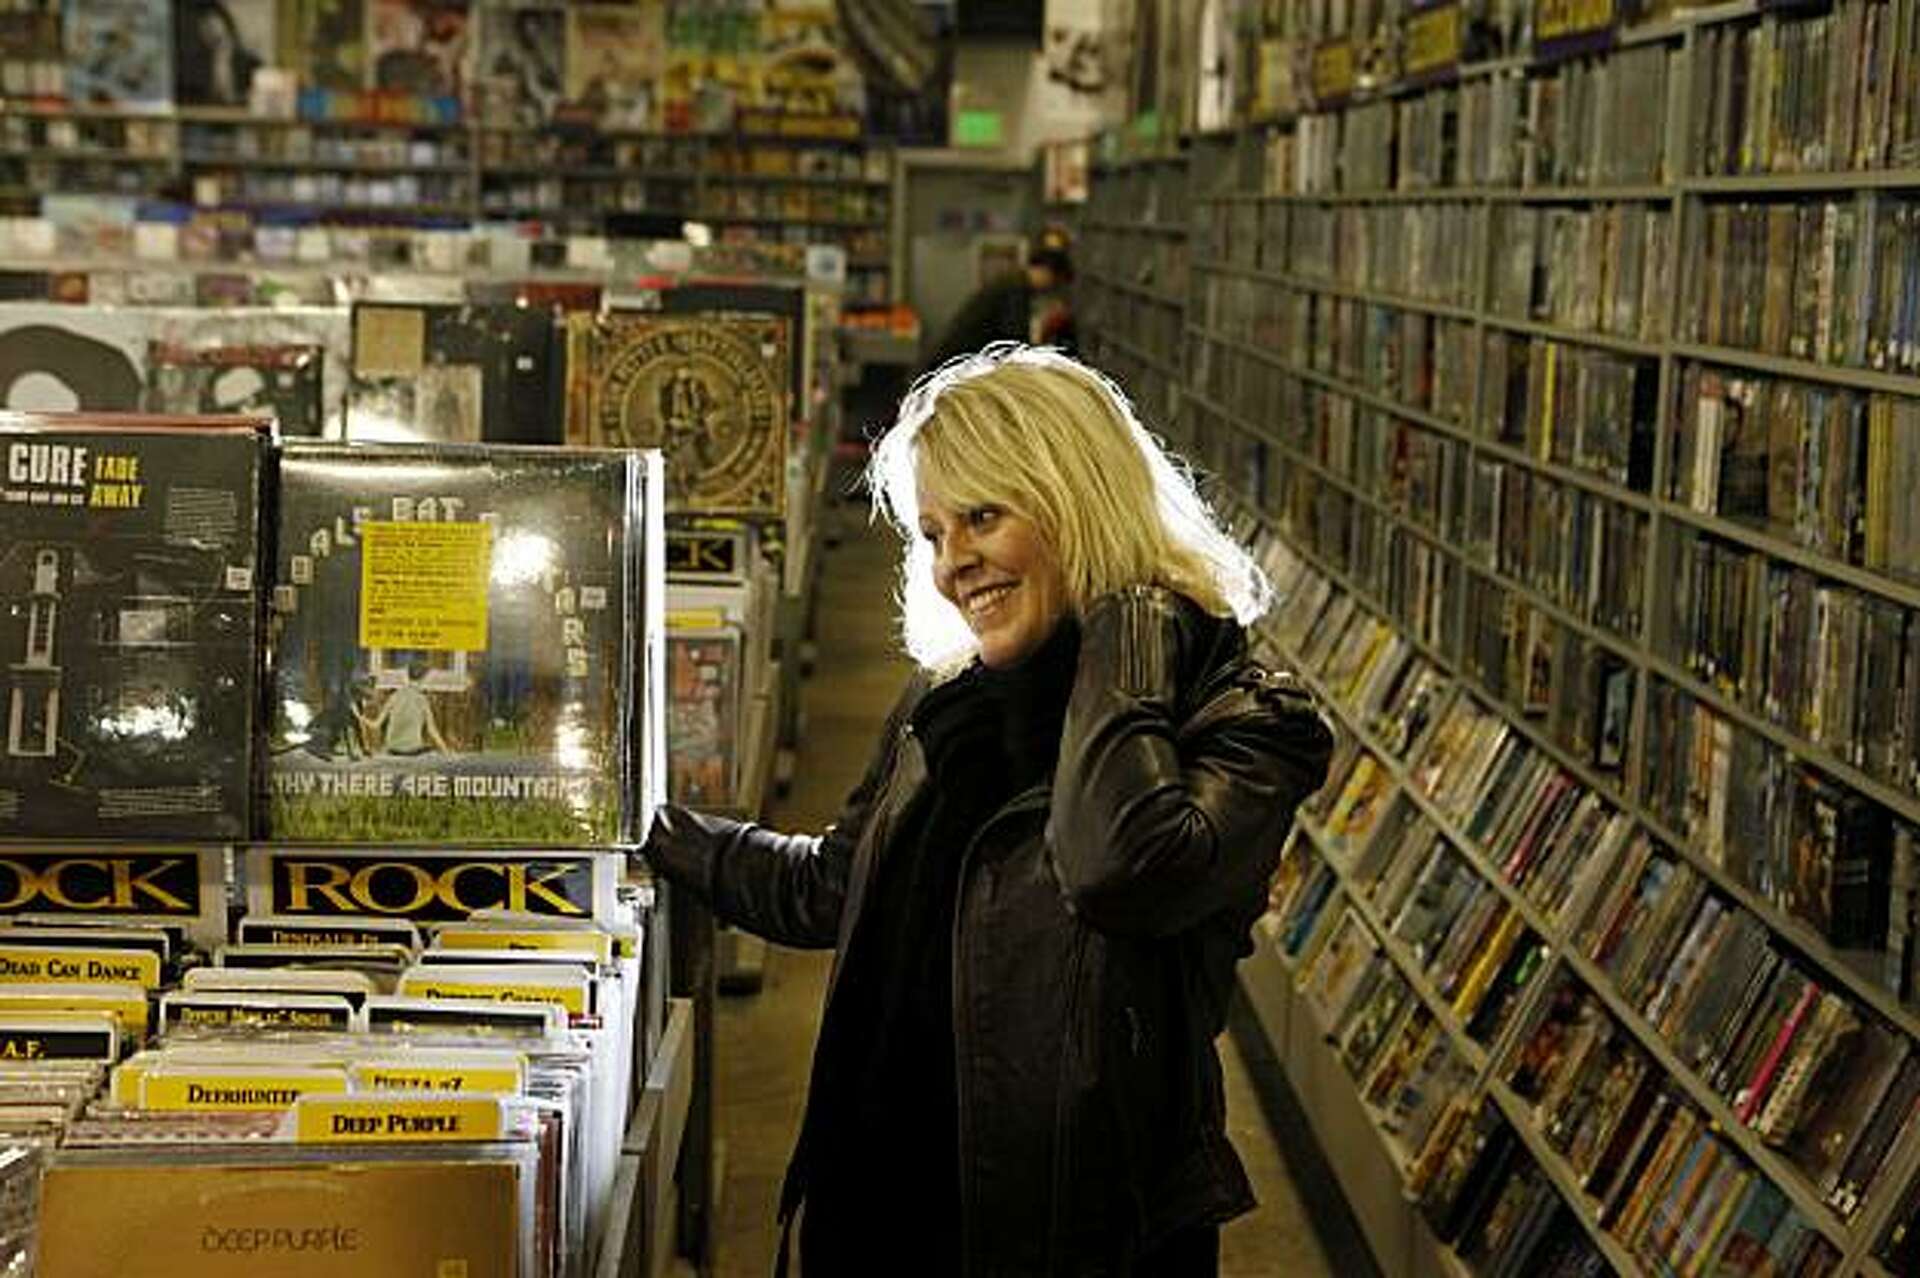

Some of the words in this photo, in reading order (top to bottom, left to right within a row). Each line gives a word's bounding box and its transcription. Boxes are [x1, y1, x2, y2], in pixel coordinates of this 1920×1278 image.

[9, 443, 88, 486] CURE
[90, 484, 143, 508] AWAY
[318, 774, 393, 798] THERE
[399, 775, 447, 798] ARE
[284, 861, 584, 915] ROCK
[48, 960, 81, 978] CAN
[88, 961, 142, 981] DANCE
[332, 1115, 382, 1134] DEEP
[387, 1115, 461, 1133] PURPLE
[201, 1226, 270, 1252] DEEP
[273, 1225, 358, 1252] PURPLE
